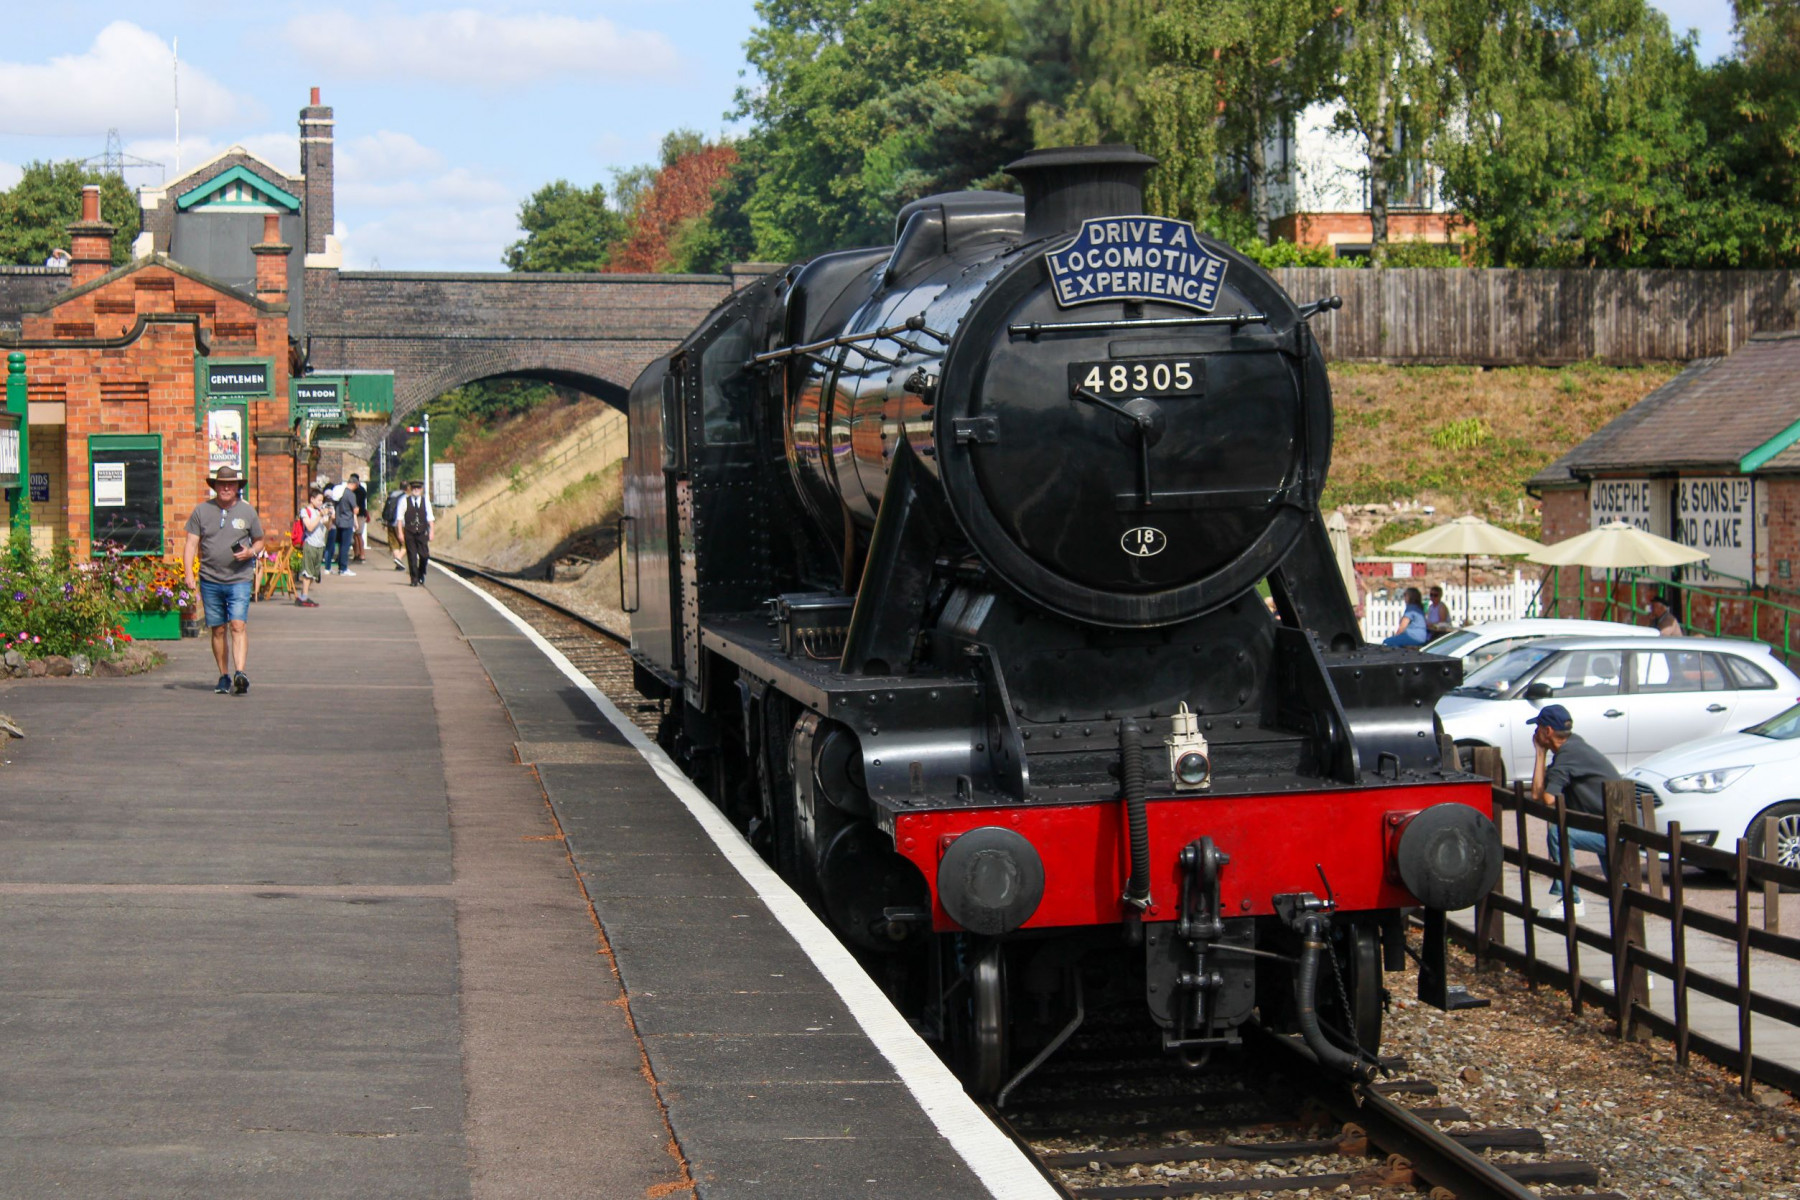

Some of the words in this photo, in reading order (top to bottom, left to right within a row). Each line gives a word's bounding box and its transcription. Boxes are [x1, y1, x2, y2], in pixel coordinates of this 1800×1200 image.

[1089, 221, 1163, 246] DRIVE
[1170, 226, 1188, 248] A
[1051, 248, 1221, 282] LOCOMOTIVE
[1059, 271, 1216, 305] EXPERIENCE
[210, 374, 264, 385] GENTLEMEN
[1083, 362, 1194, 394] 48305
[298, 390, 311, 398] TEA
[312, 390, 335, 398] ROOM
[210, 453, 237, 461] LONDON
[30, 474, 48, 486] OIDS
[1681, 482, 1688, 512] &
[1137, 529, 1154, 544] 18
[1703, 518, 1742, 548] CAKE
[1139, 543, 1149, 555] A
